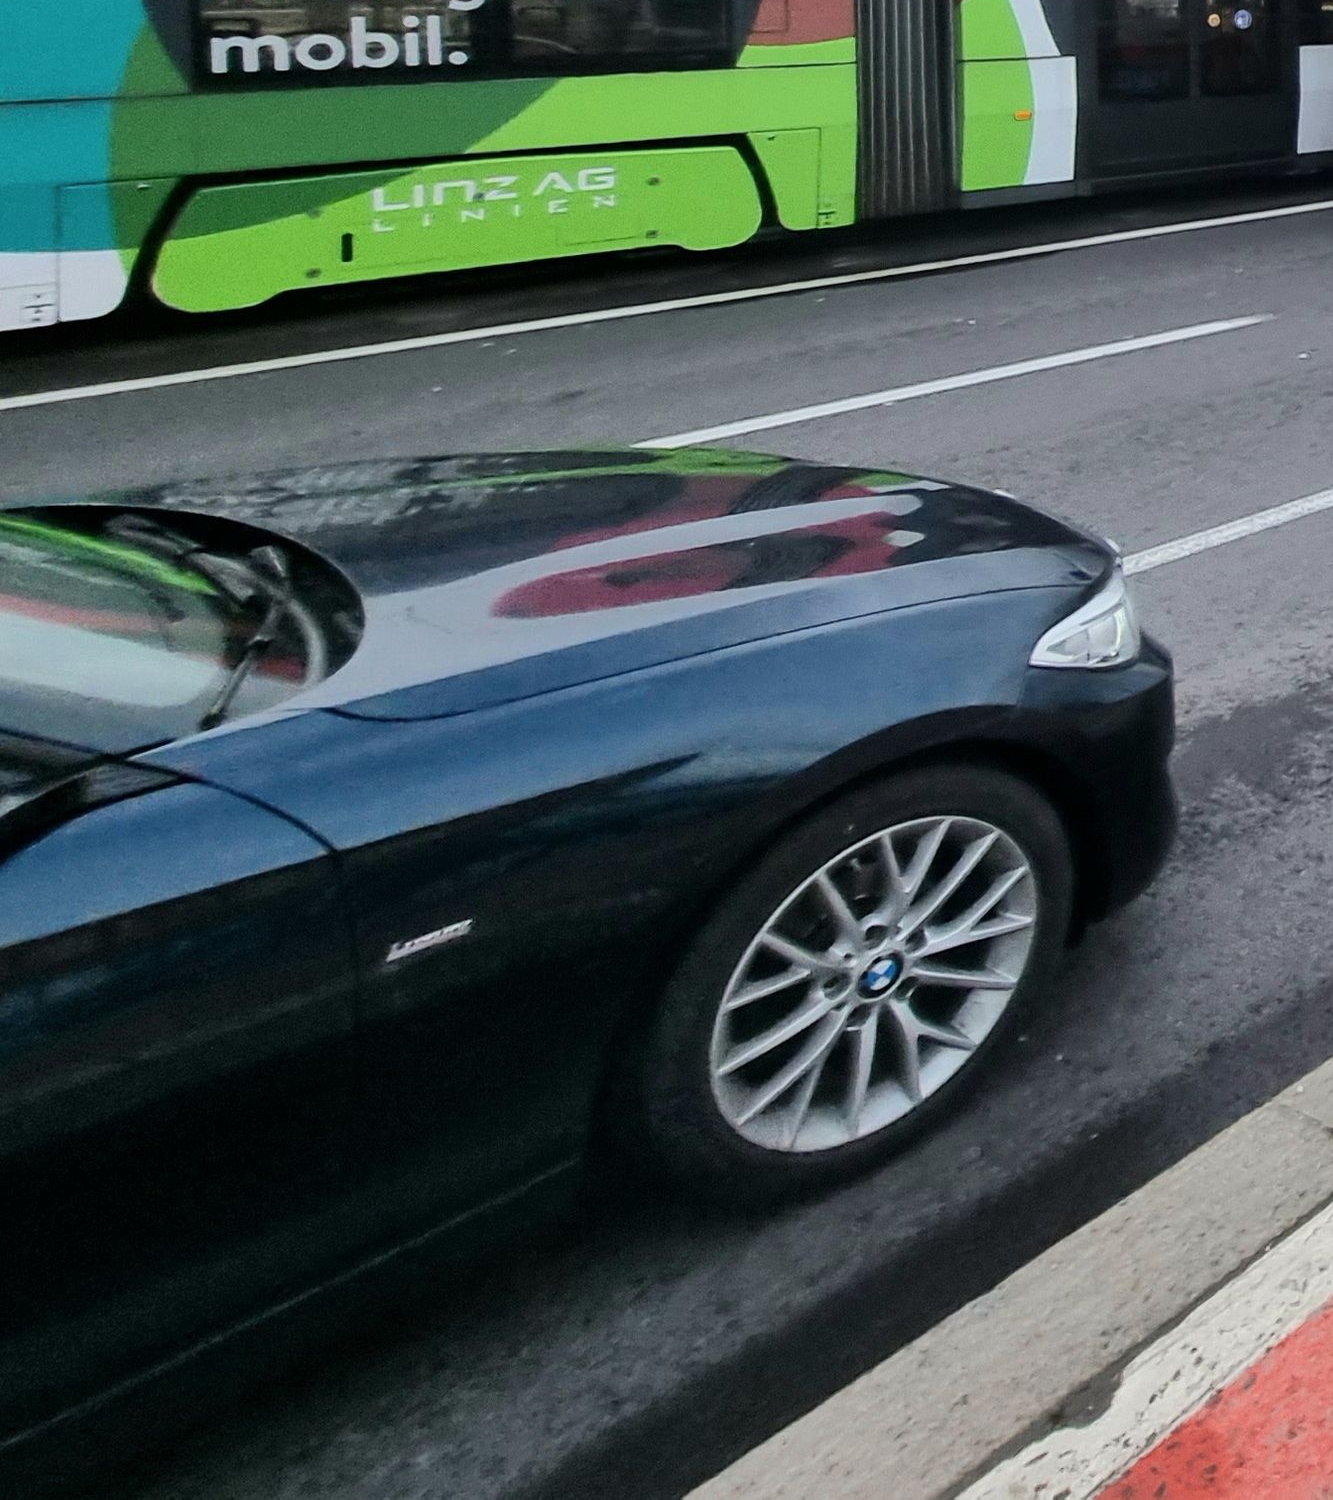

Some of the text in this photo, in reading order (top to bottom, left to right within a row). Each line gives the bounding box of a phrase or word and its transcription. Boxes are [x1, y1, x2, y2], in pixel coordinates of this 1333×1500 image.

[210, 15, 469, 74] mobil.
[373, 166, 616, 212] LINZ AG
[372, 194, 616, 233] LINIEN
